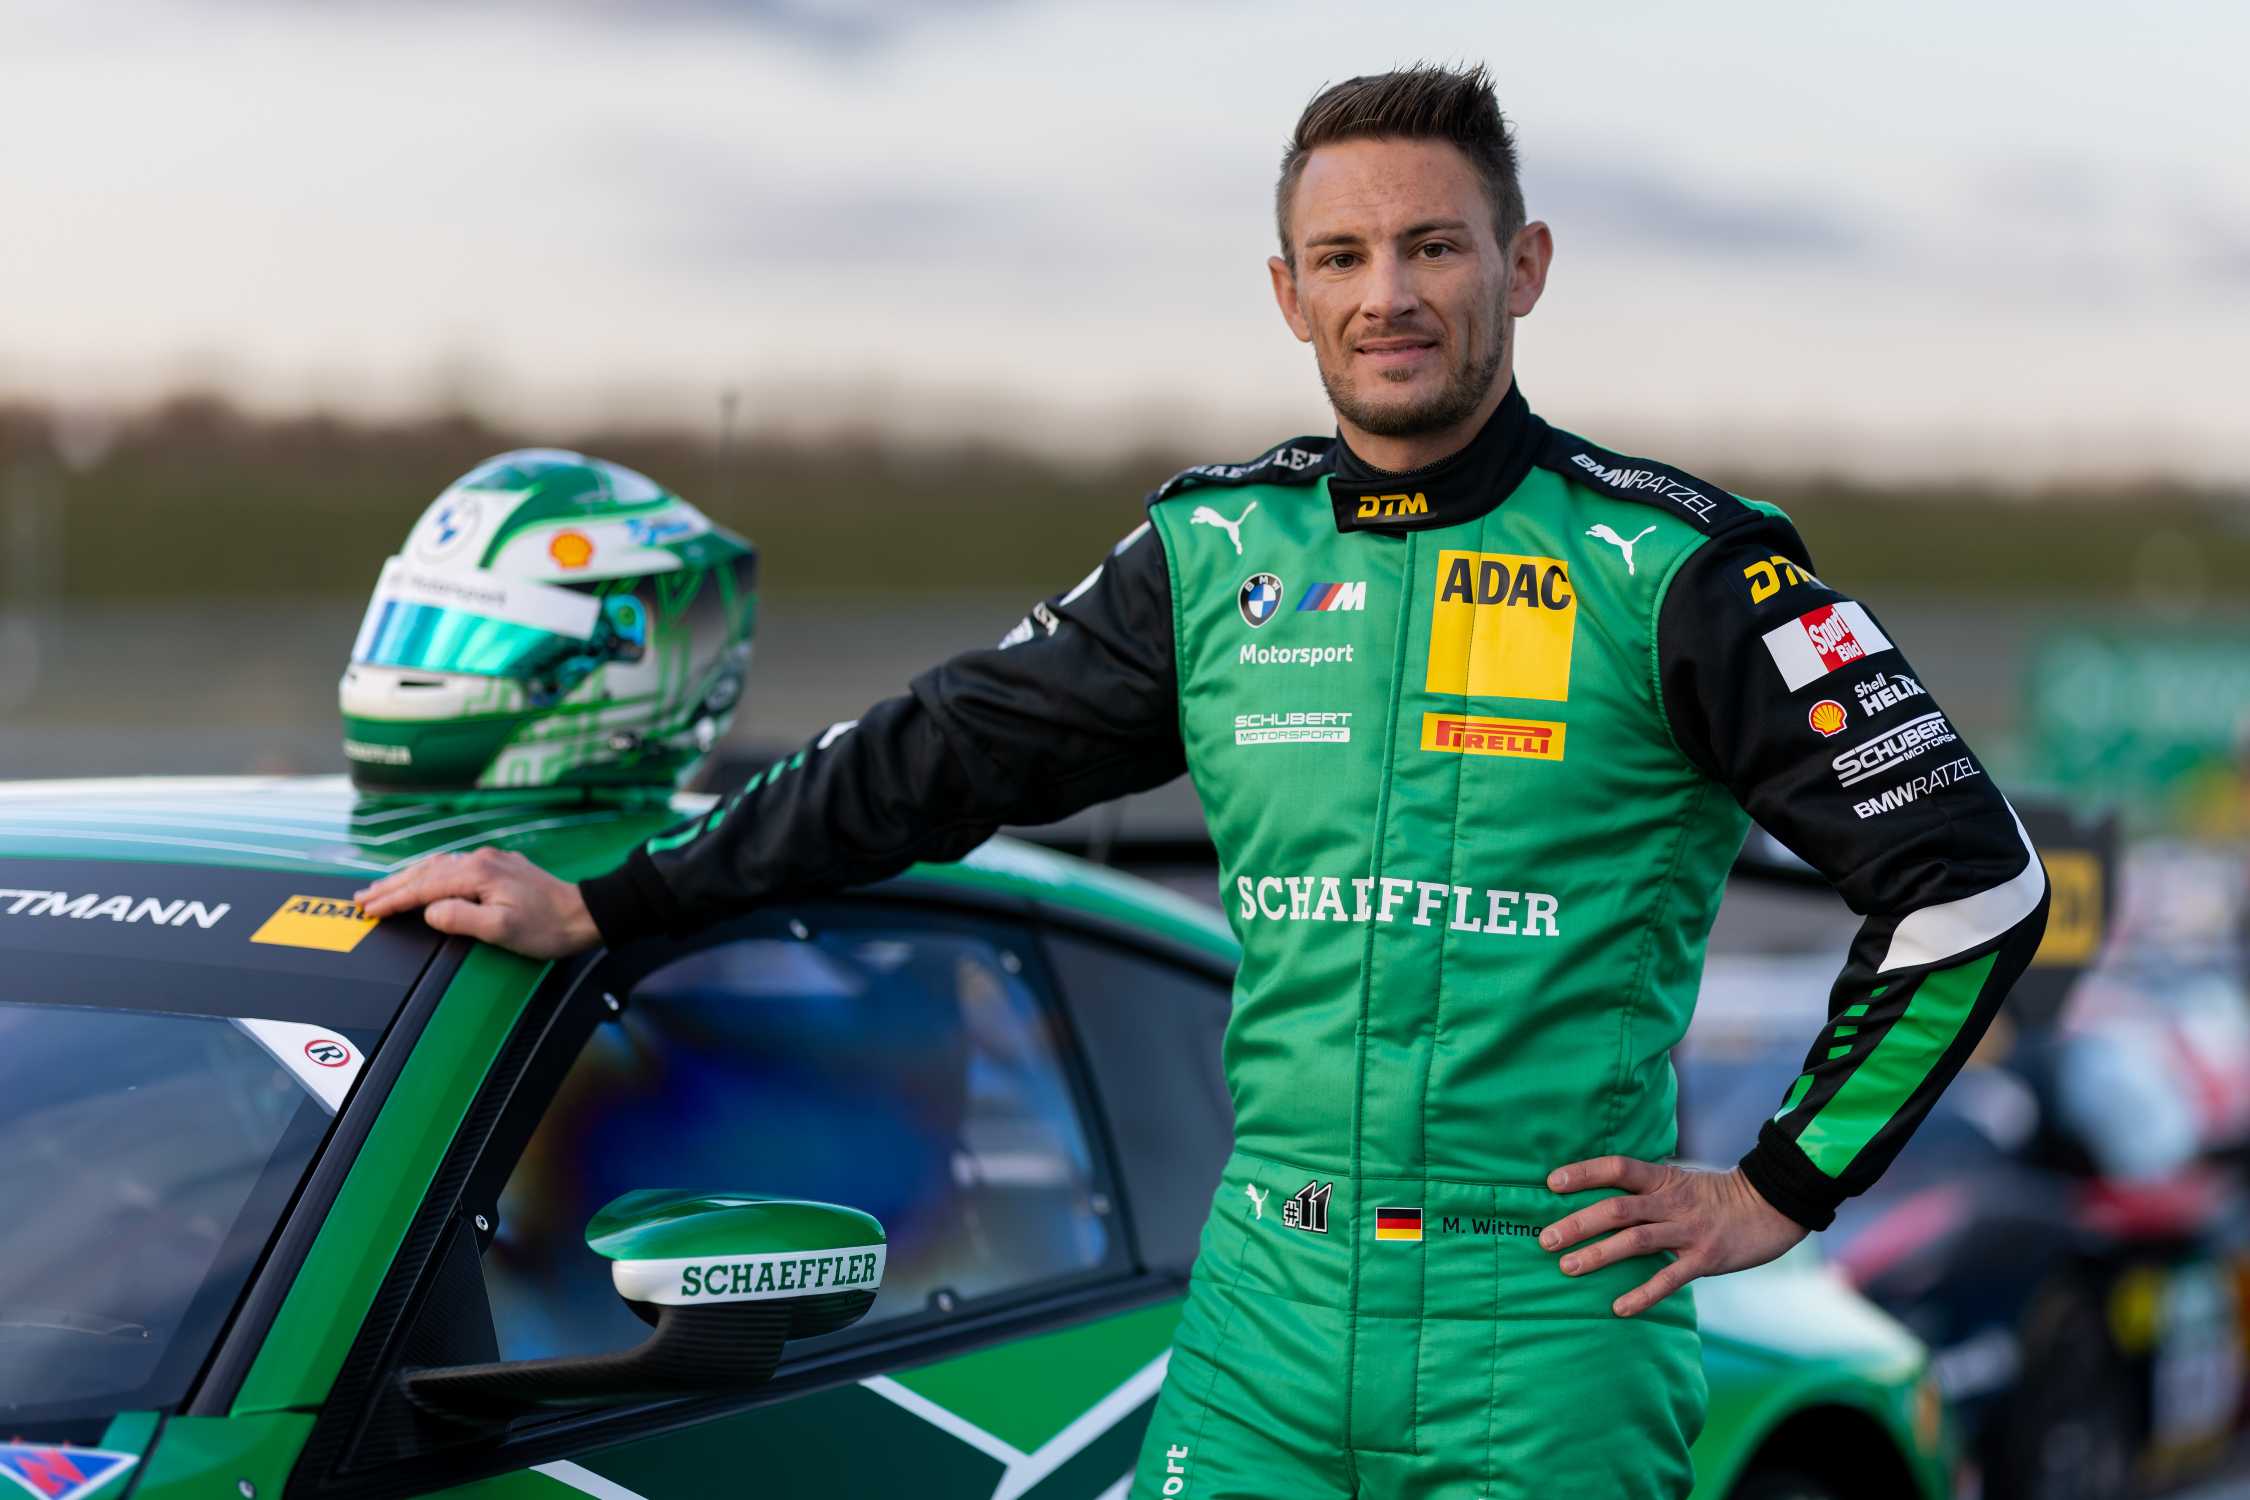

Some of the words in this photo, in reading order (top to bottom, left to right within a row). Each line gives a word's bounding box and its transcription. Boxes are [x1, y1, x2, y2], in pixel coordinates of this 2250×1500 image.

[1357, 492, 1429, 519] DTM
[1327, 581, 1367, 611] M
[1441, 558, 1572, 611] ADAC
[1808, 606, 1851, 656] Sport
[1239, 644, 1355, 668] Motorsport
[1835, 639, 1864, 663] Bild
[1854, 672, 1887, 698] Shell
[1859, 677, 1927, 717] HELIX
[1235, 712, 1353, 728] SCHUBERT
[1239, 729, 1346, 743] MOTORSPORT
[1435, 720, 1553, 754] PIRELLI
[1832, 713, 1950, 785] SCHUBERT
[1236, 875, 1561, 937] SCHAEFFLER
[1283, 1180, 1333, 1234] #11
[1442, 1216, 1466, 1234] M.
[681, 1252, 878, 1297] SCHAEFFLER
[1162, 1444, 1189, 1500] ort
